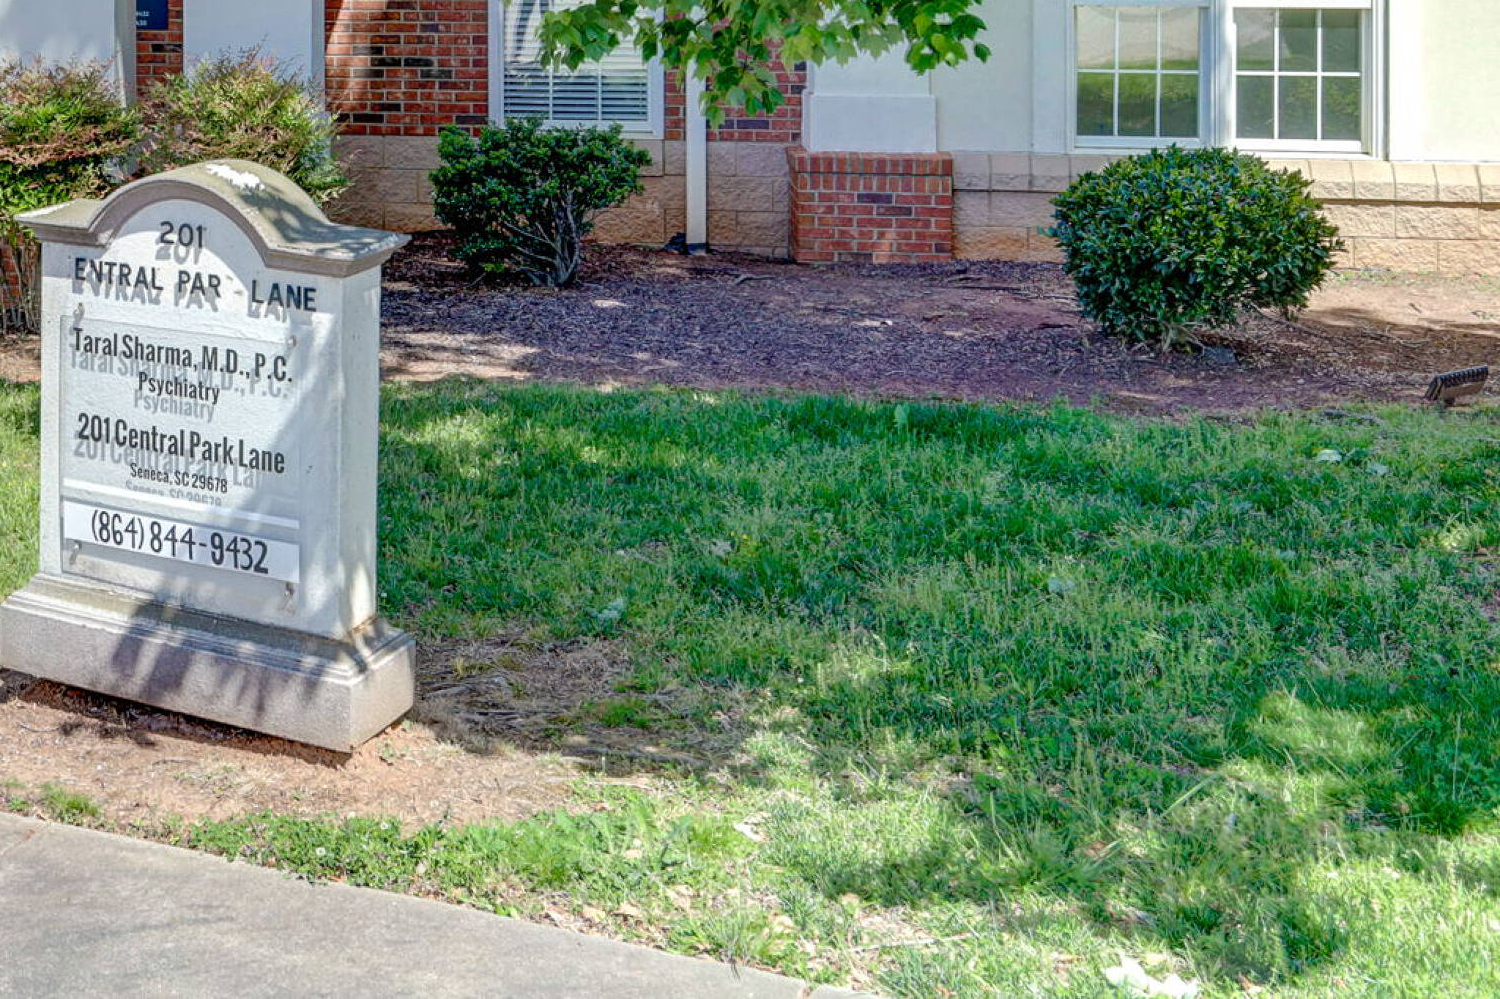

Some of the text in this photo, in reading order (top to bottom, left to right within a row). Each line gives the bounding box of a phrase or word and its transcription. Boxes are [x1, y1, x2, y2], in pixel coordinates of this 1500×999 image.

[158, 220, 203, 249] 201
[251, 279, 317, 312] LANE
[72, 327, 293, 383] Taral Sharma, M.D., P.C.
[138, 371, 220, 405] Psychiatry
[77, 412, 285, 474] 201 Central Park Lane
[174, 470, 190, 486] SC
[191, 474, 228, 493] 29678
[91, 509, 270, 575] (864) 844-9432
